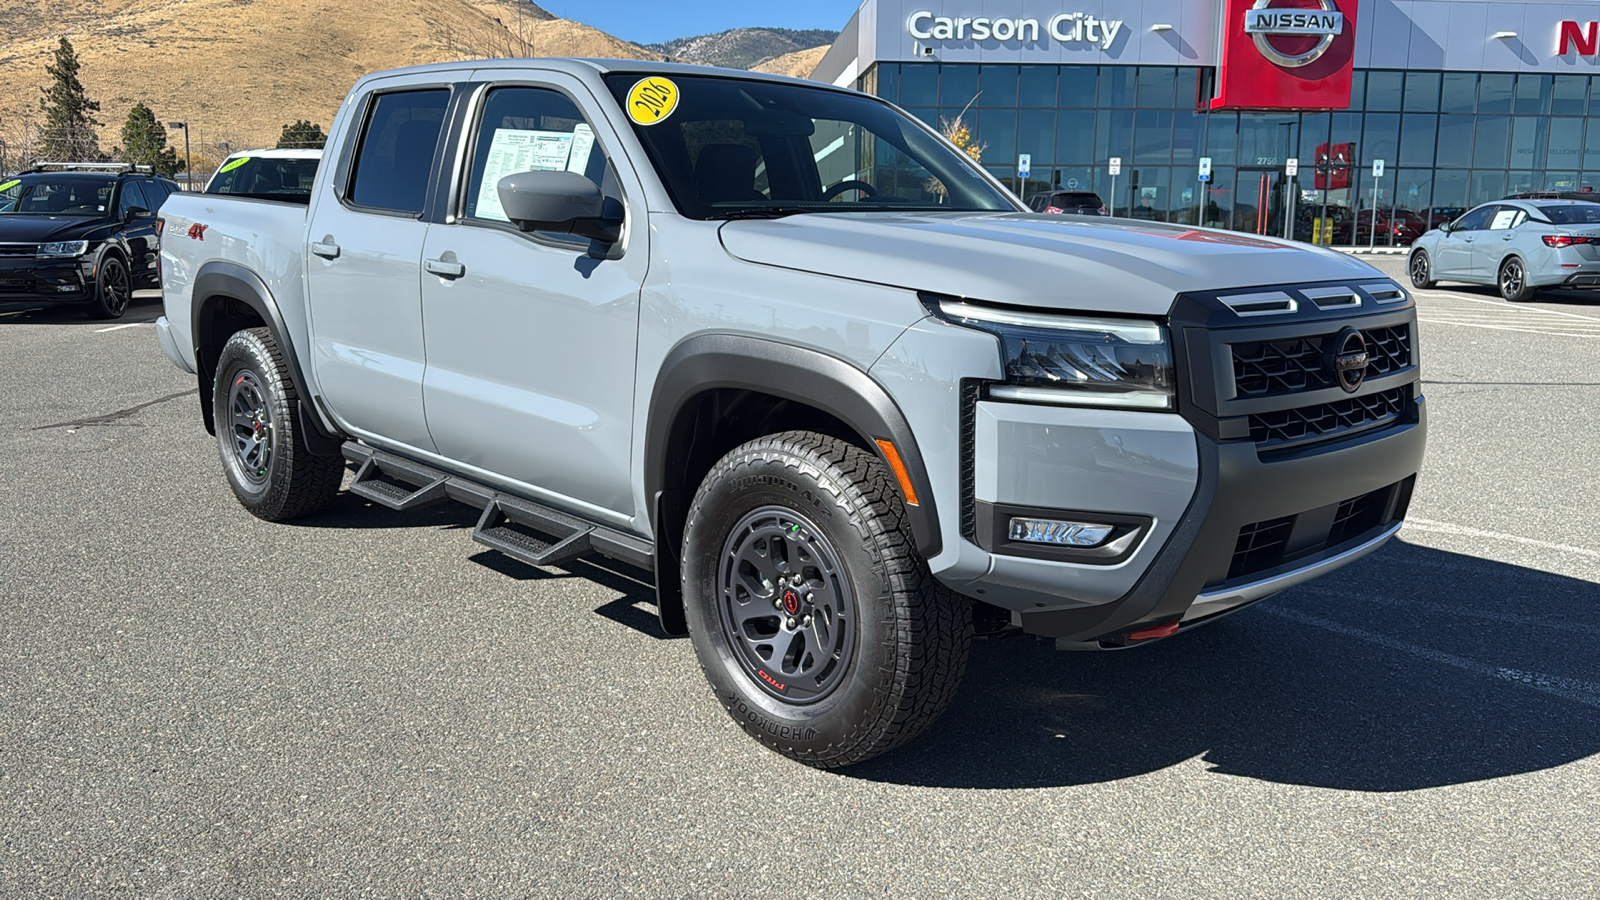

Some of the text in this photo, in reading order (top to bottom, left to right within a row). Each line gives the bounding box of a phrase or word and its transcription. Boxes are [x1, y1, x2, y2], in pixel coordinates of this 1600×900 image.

[907, 11, 1123, 50] Carson City
[1256, 14, 1335, 30] NISSAN
[1556, 20, 1598, 56] N
[635, 80, 671, 117] 2026
[758, 670, 785, 690] PRO
